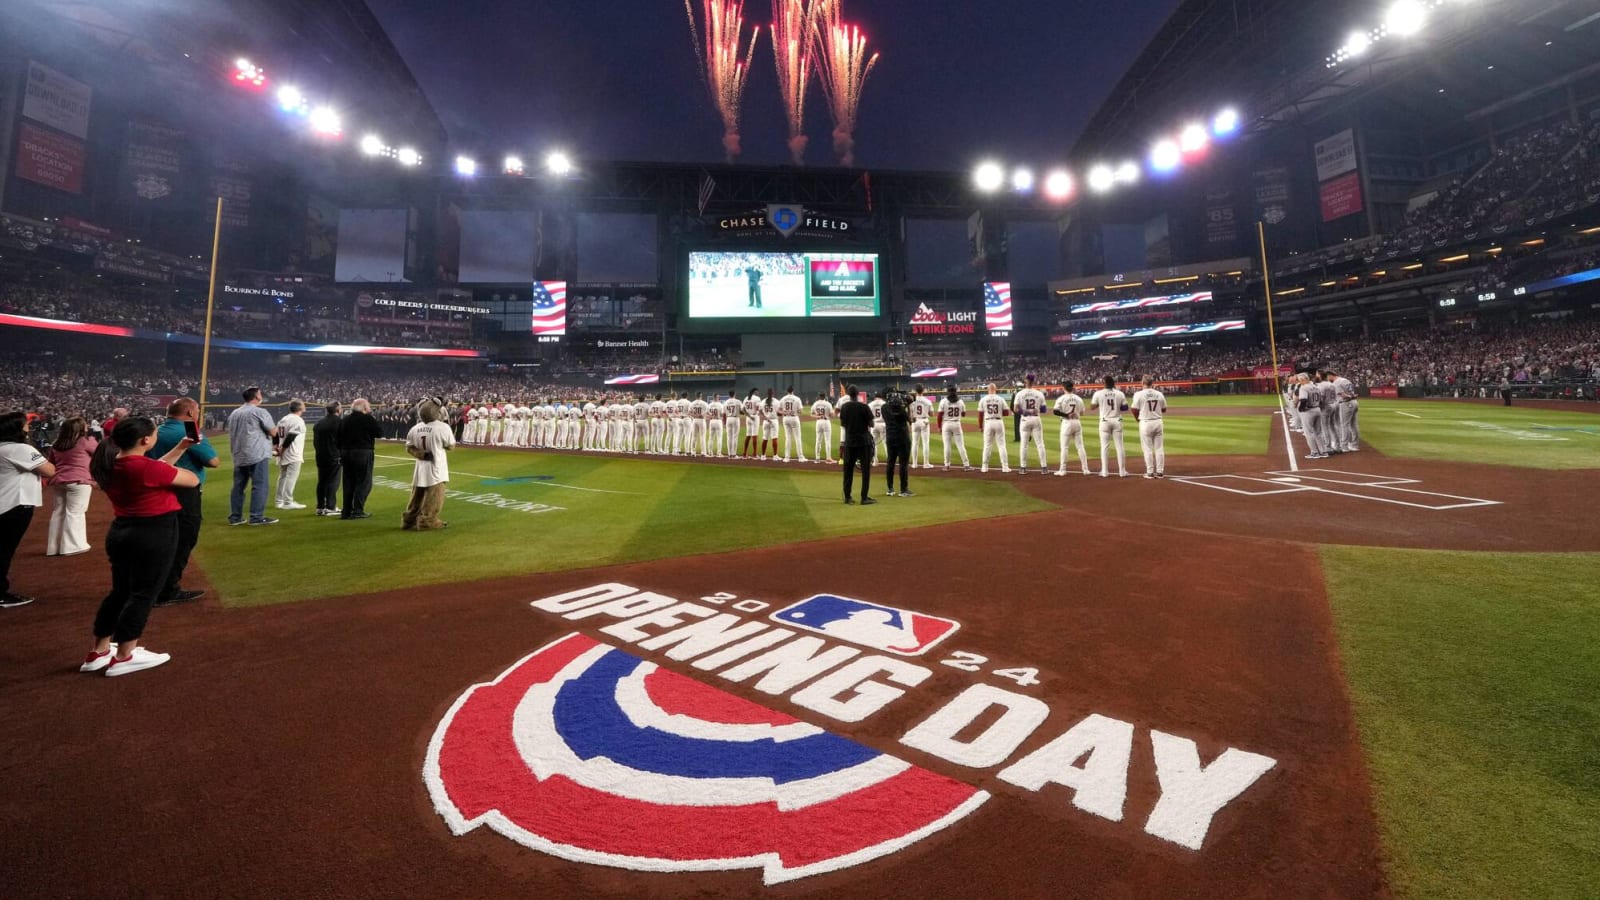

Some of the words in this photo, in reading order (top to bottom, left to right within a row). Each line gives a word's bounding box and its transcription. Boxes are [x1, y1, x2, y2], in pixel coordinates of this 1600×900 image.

[720, 217, 765, 228] CHASE
[806, 218, 848, 230] FIELD
[1114, 274, 1124, 282] 42
[261, 288, 270, 296] &
[1478, 292, 1496, 301] 6:58
[398, 300, 423, 309] BEERS
[430, 303, 490, 314] CHEESEBURGERS
[1439, 298, 1455, 307] 6:58
[947, 312, 977, 321] LIGHT
[912, 324, 946, 334] STRIKE
[948, 324, 974, 334] ZONE
[629, 339, 649, 347] Health
[785, 402, 793, 410] 81
[986, 404, 998, 414] 53
[1025, 398, 1035, 410] 12
[1069, 404, 1076, 414] 7
[1106, 399, 1114, 411] 4
[1147, 399, 1158, 412] 17
[726, 405, 735, 414] 47
[917, 405, 922, 415] 9
[948, 407, 959, 417] 28
[700, 590, 771, 615] 20
[941, 649, 1042, 688] 24
[529, 581, 934, 723] OPENING
[897, 684, 1278, 851] DAY
